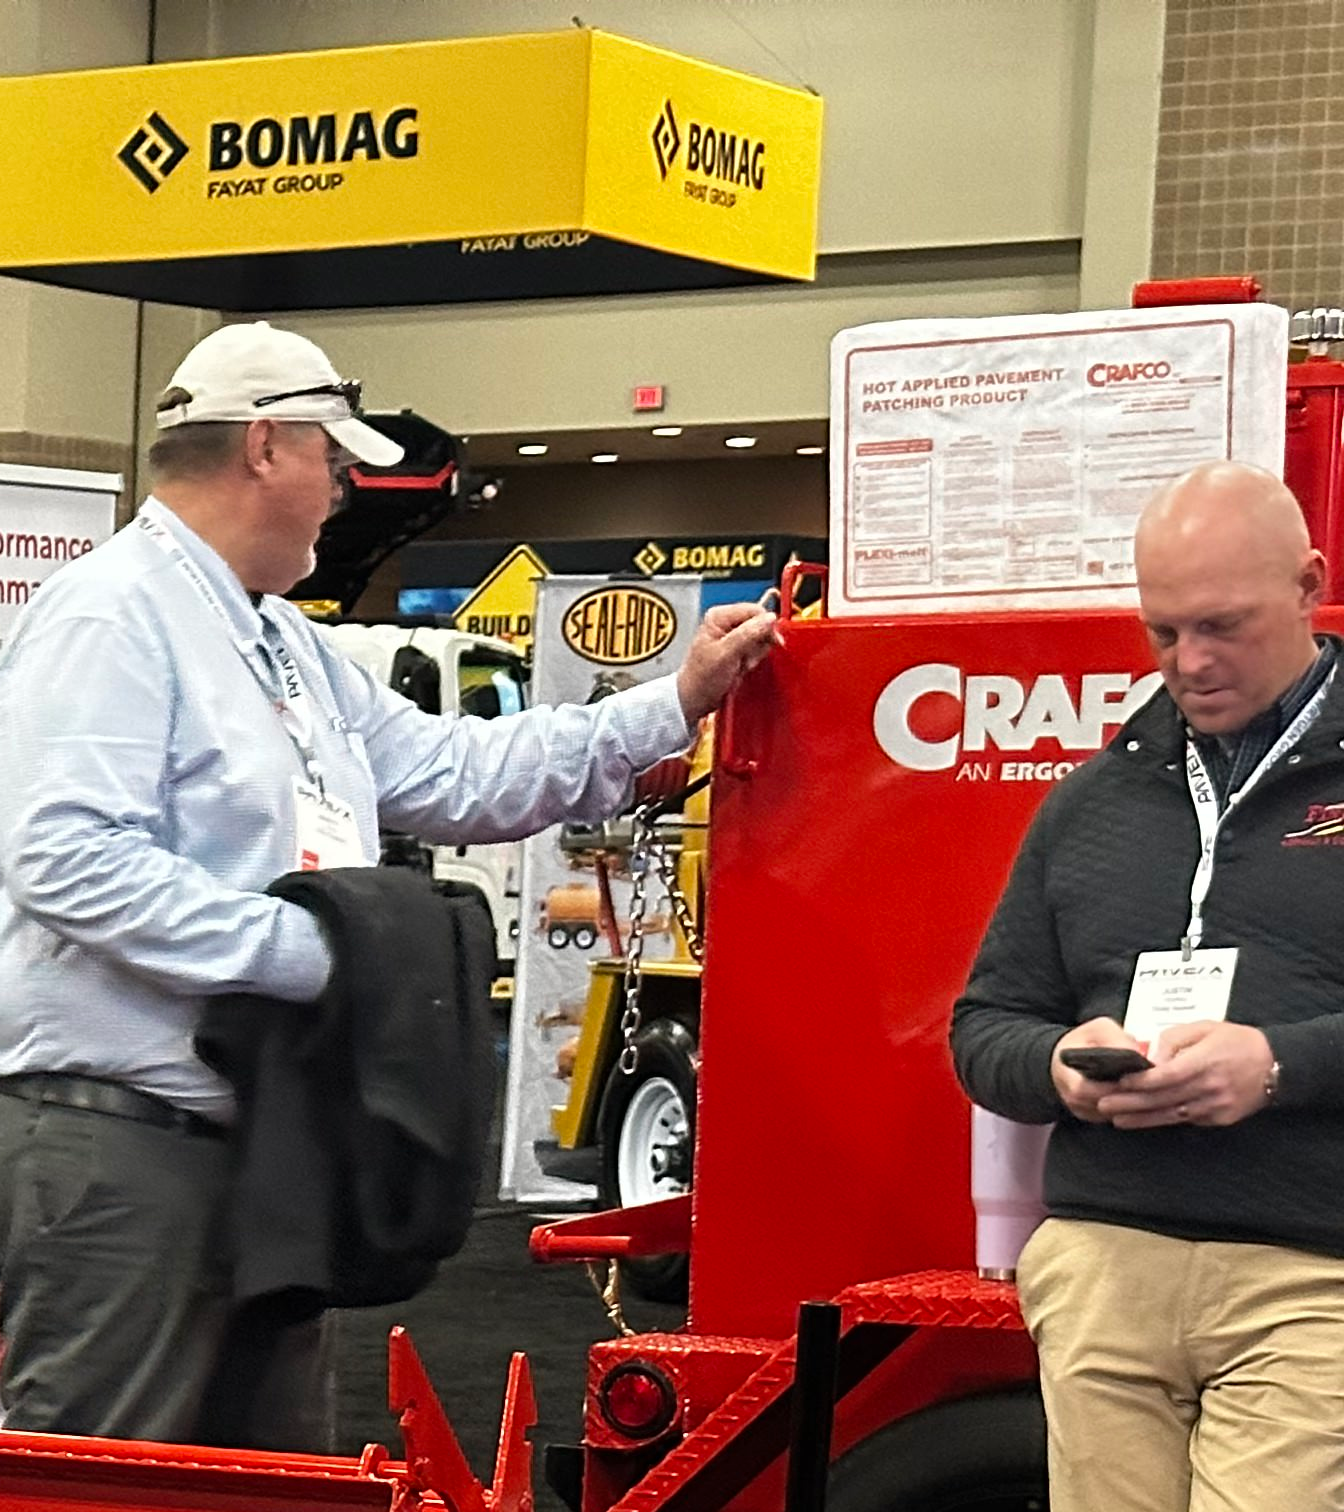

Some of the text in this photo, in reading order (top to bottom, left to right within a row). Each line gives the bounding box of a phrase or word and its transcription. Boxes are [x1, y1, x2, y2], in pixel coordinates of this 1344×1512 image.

[209, 108, 418, 171] BOMAG
[686, 123, 765, 190] BOMAG
[207, 173, 344, 199] FAYAT GROUP
[862, 368, 1065, 395] HOT APPLIED PAVEMENT
[1086, 360, 1171, 387] CRAFCO
[862, 389, 1028, 413] PATCHING PRODUCT
[672, 545, 765, 568] BOMAG
[570, 590, 669, 658] SEAL-RITE
[956, 762, 1082, 782] AN ERGO
